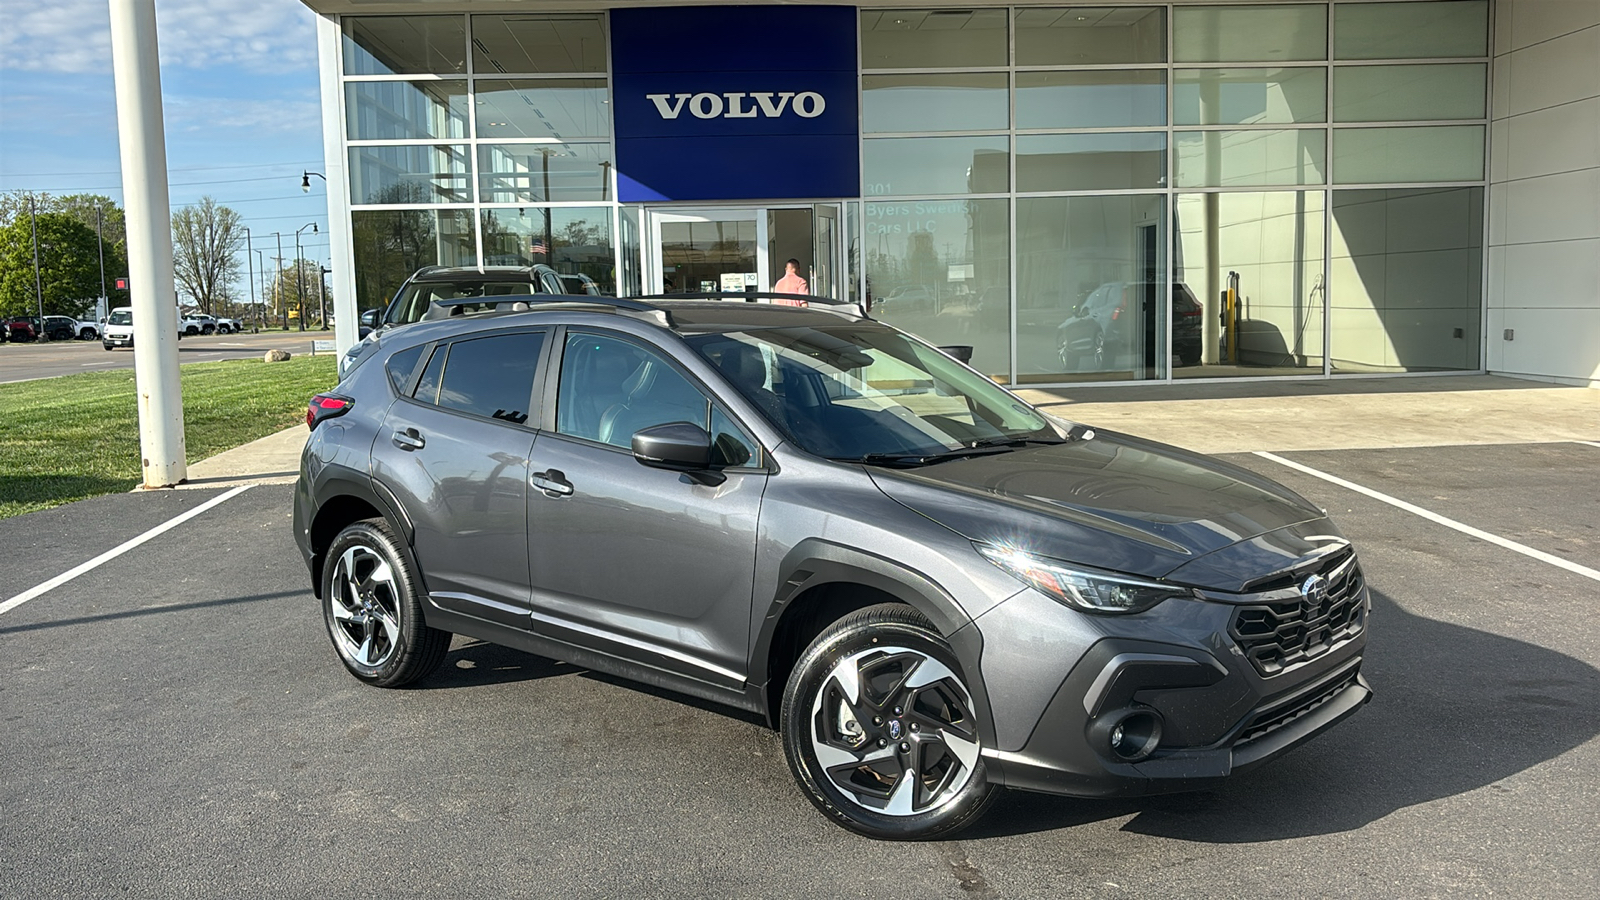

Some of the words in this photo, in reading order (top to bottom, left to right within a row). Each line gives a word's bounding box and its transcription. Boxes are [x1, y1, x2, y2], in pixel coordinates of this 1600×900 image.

[646, 91, 826, 119] VOLVO
[866, 183, 892, 195] 301
[866, 204, 910, 219] Byers
[915, 202, 979, 215] Swedish
[866, 221, 902, 234] Cars
[907, 220, 937, 233] LLC
